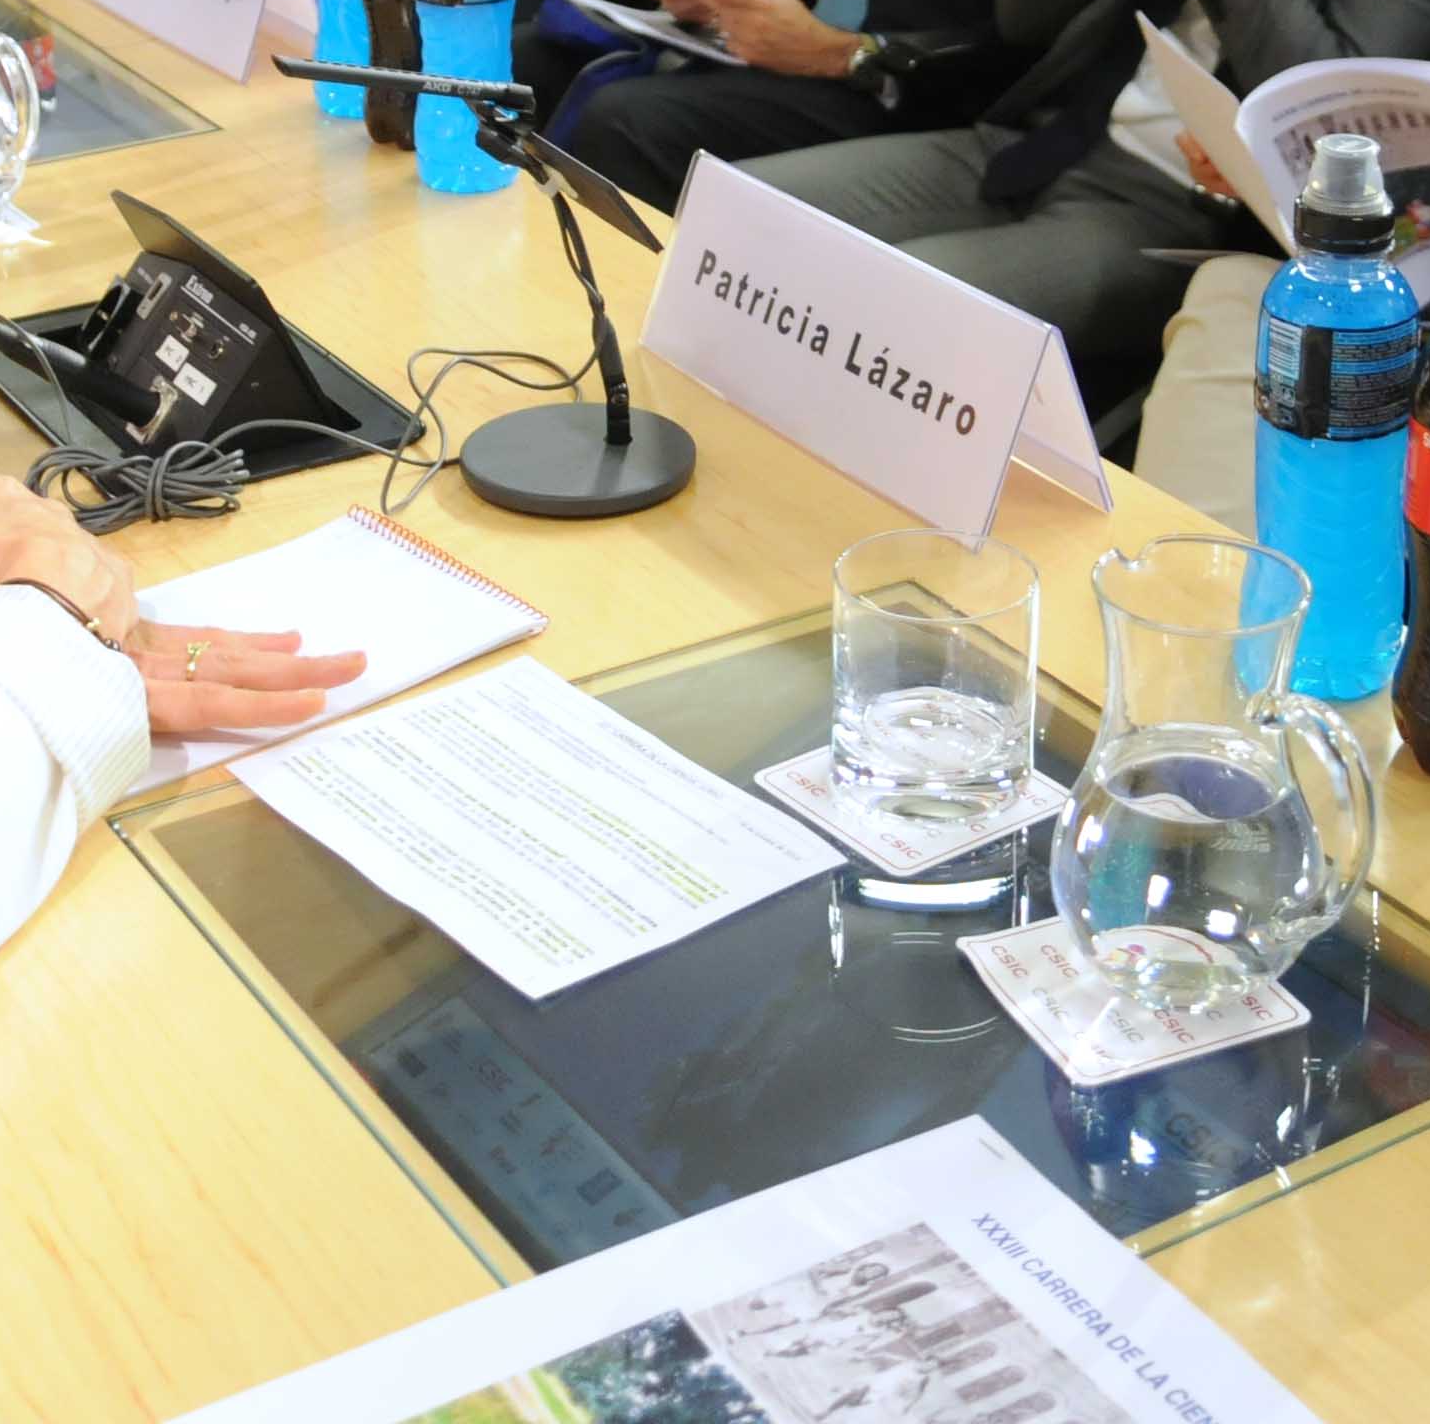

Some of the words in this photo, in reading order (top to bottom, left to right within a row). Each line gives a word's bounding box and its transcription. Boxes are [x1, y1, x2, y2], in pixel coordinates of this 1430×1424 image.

[694, 248, 831, 356] Patricia
[844, 332, 978, 437] Lázaro
[785, 770, 828, 798] CSIC
[879, 832, 922, 860] CSIC
[991, 945, 1028, 978] CSIC
[1039, 943, 1079, 979] CSIC
[1153, 1007, 1197, 1045] CSIC
[1241, 994, 1273, 1022] SIC
[971, 1212, 1029, 1259] XXXIII
[1020, 1255, 1113, 1338] CARRERA
[1106, 1334, 1145, 1364] DE
[1134, 1360, 1171, 1391] LA
